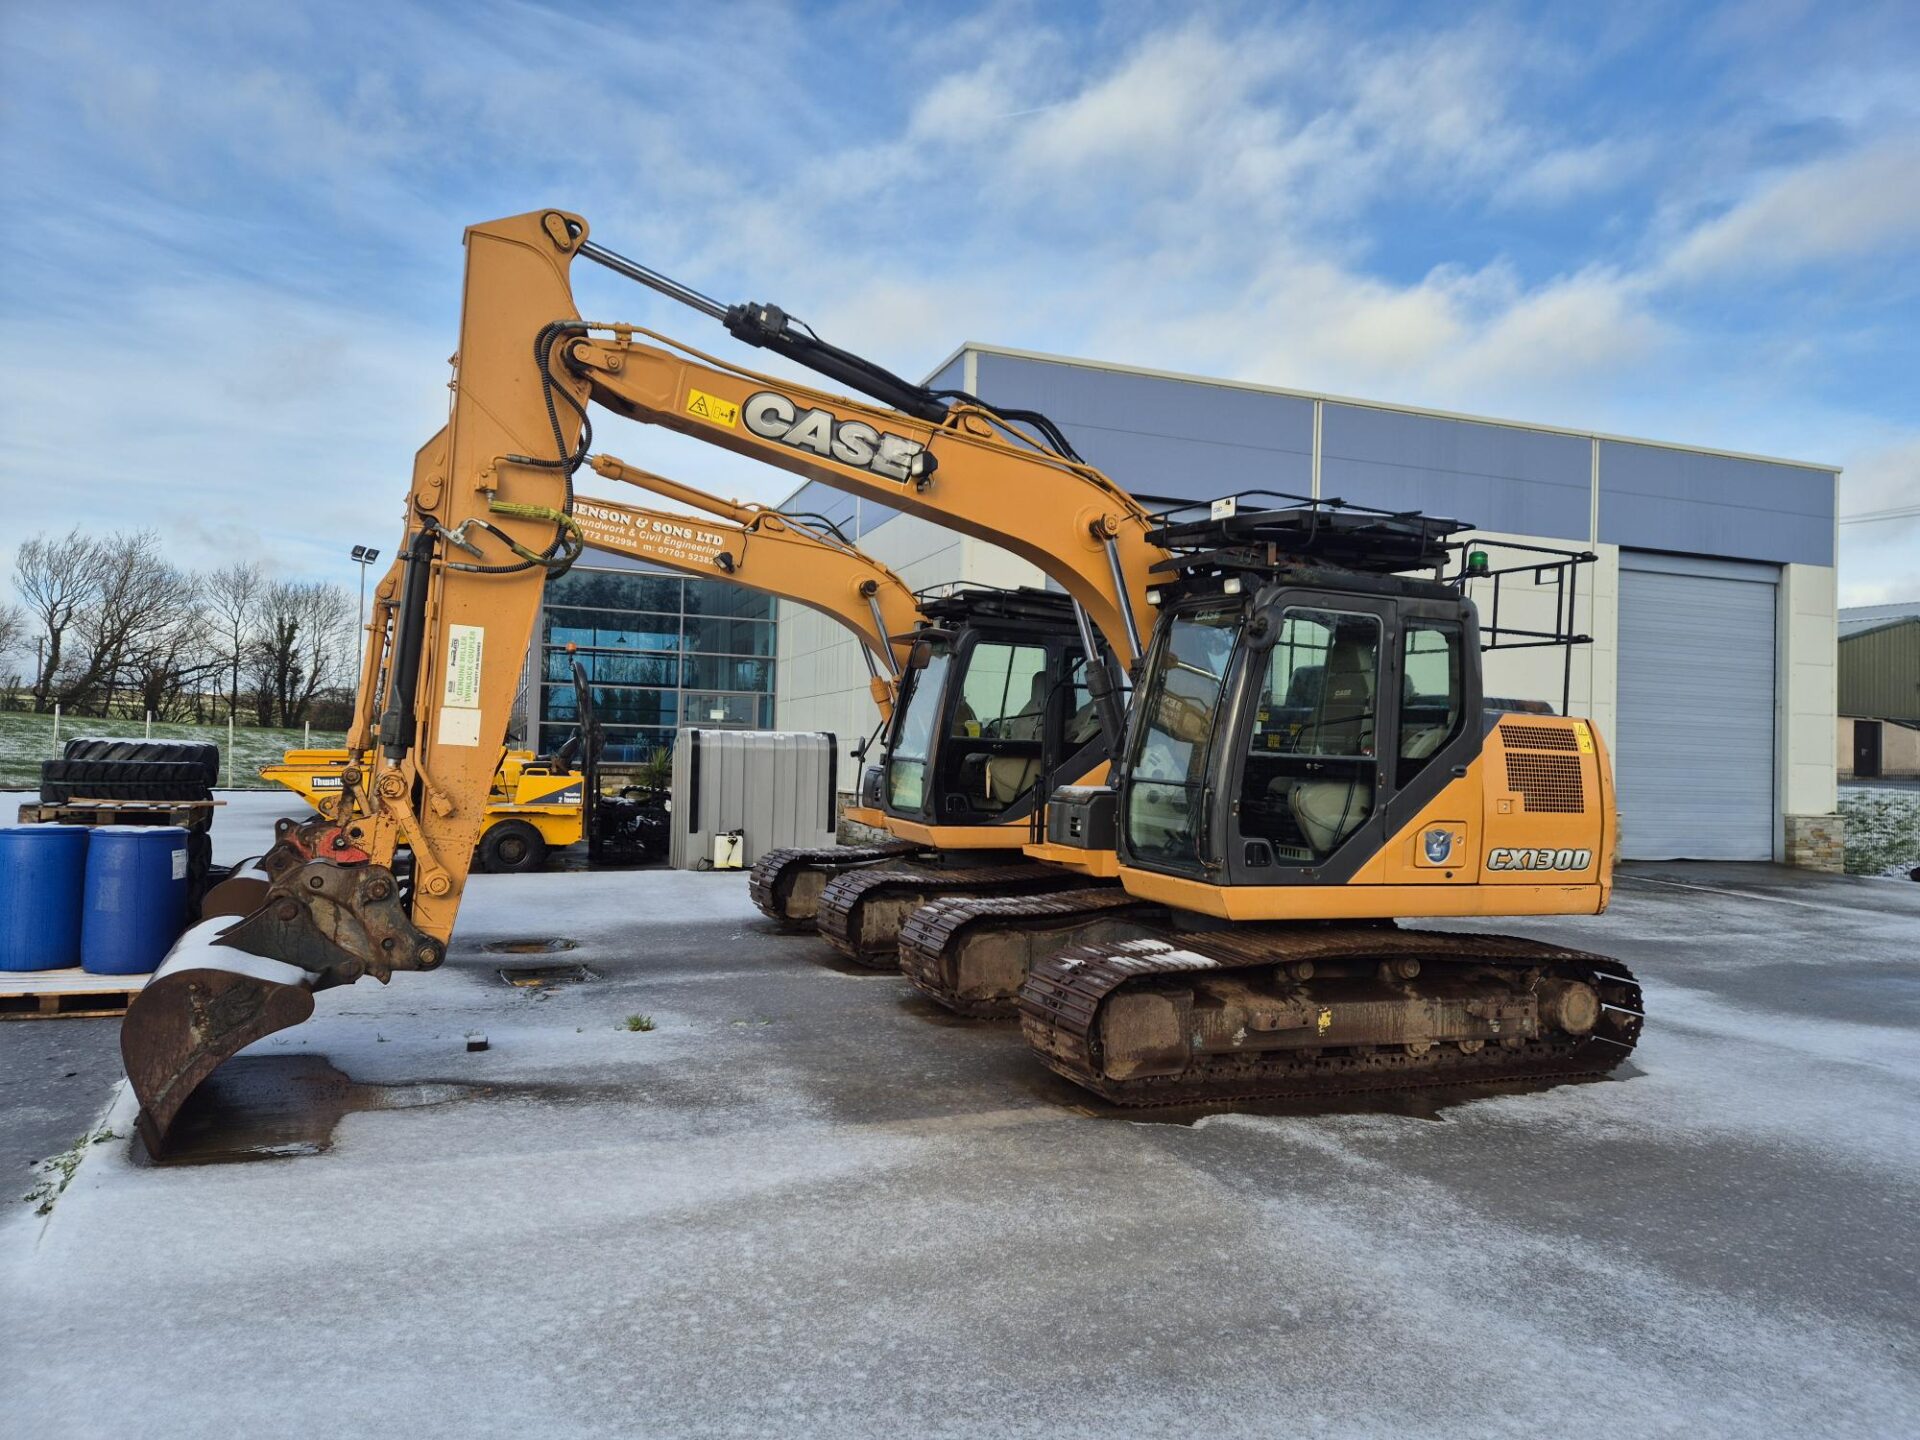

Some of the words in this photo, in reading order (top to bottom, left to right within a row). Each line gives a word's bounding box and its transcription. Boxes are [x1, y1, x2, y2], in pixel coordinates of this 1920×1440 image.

[743, 392, 924, 483] CASE
[572, 516, 625, 535] oundwork
[628, 528, 636, 537] &
[639, 530, 662, 543] Civil
[663, 536, 721, 558] Engineering
[636, 517, 649, 529] &
[652, 521, 692, 539] SONS
[696, 531, 724, 546] LTD
[658, 546, 686, 559] 07703
[687, 552, 714, 565] 52382
[313, 778, 343, 786] Thwait
[1487, 848, 1592, 871] CX130D
